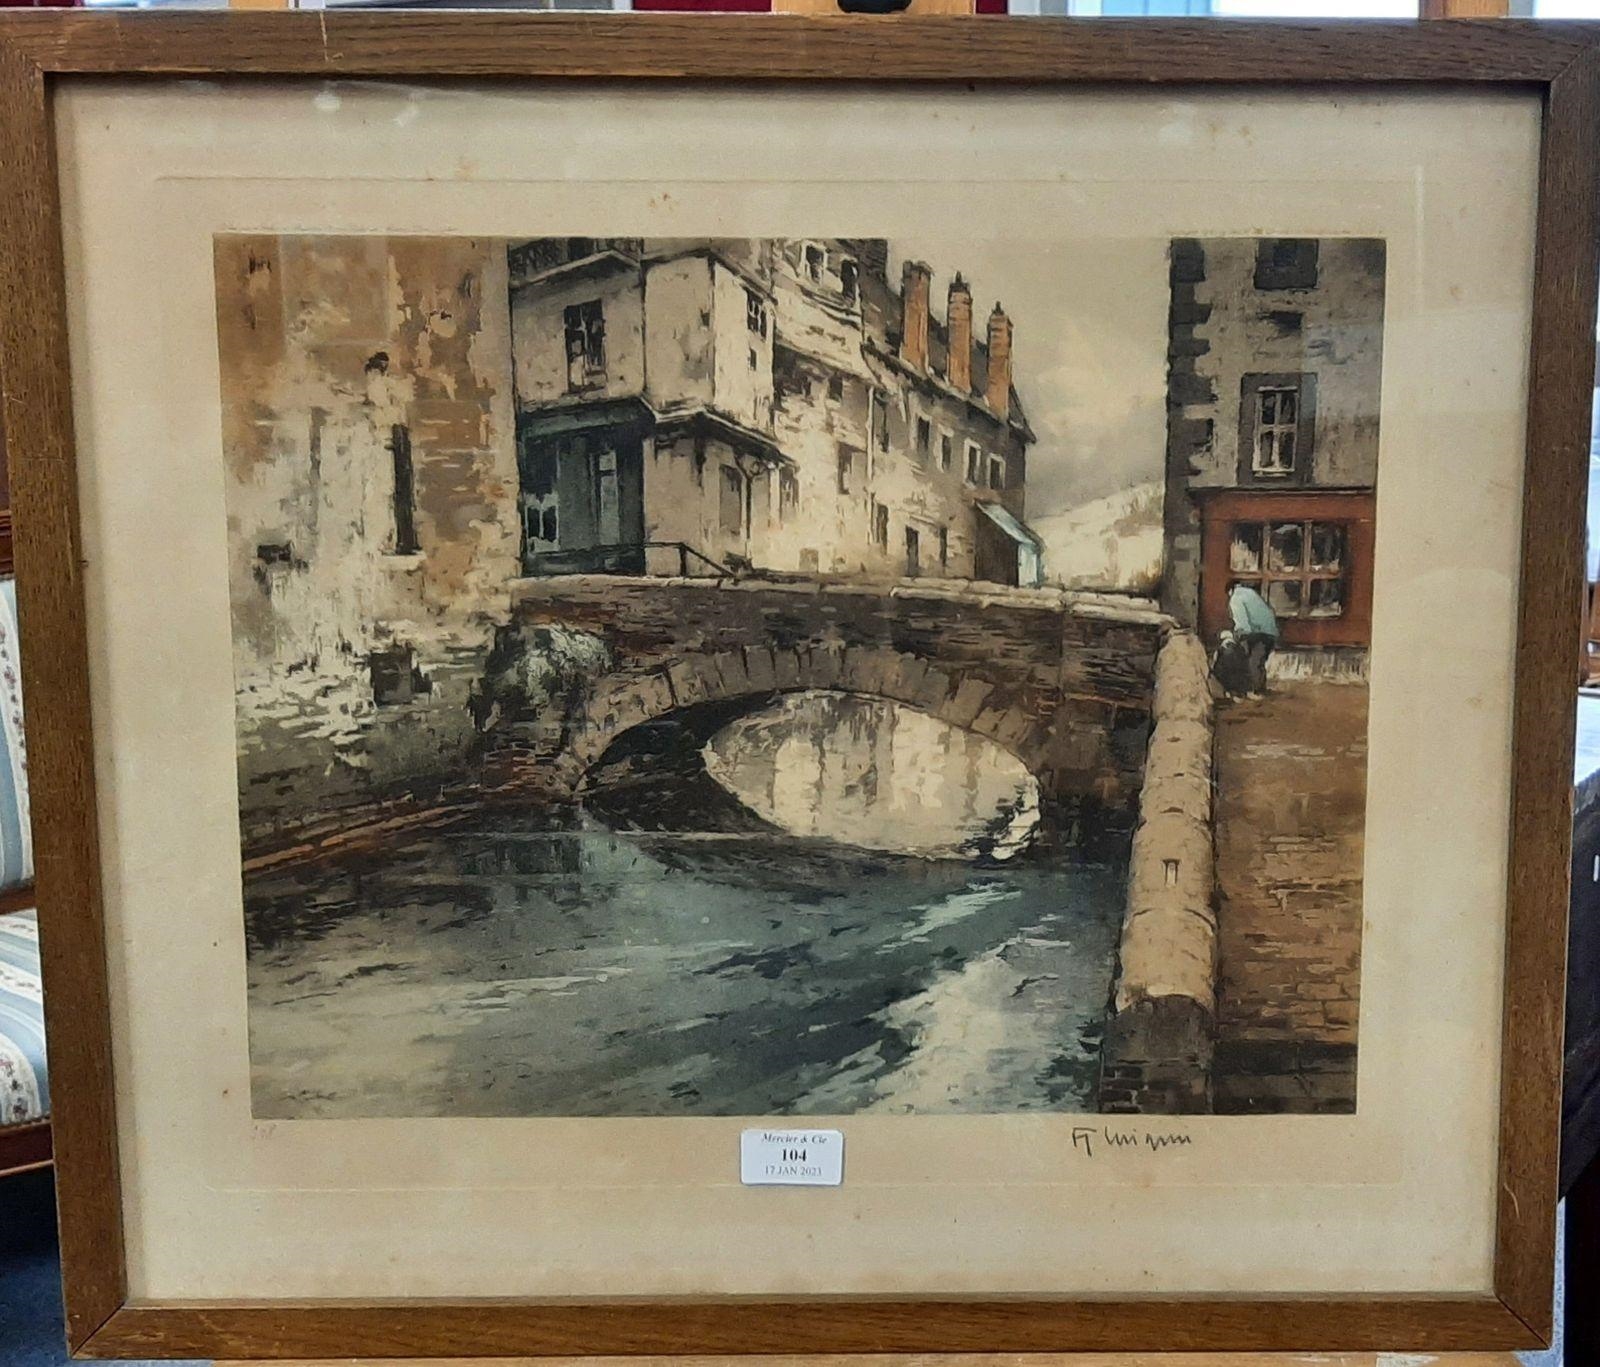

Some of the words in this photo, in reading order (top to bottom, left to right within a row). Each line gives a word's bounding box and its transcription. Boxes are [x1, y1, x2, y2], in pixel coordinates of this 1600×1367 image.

[761, 1133, 798, 1144] Mercier
[800, 1135, 808, 1144] &
[811, 1135, 828, 1144] Cie
[782, 1148, 807, 1162] 104
[765, 1165, 775, 1175] 17
[777, 1166, 798, 1176] JAN
[800, 1167, 822, 1177] 2023
